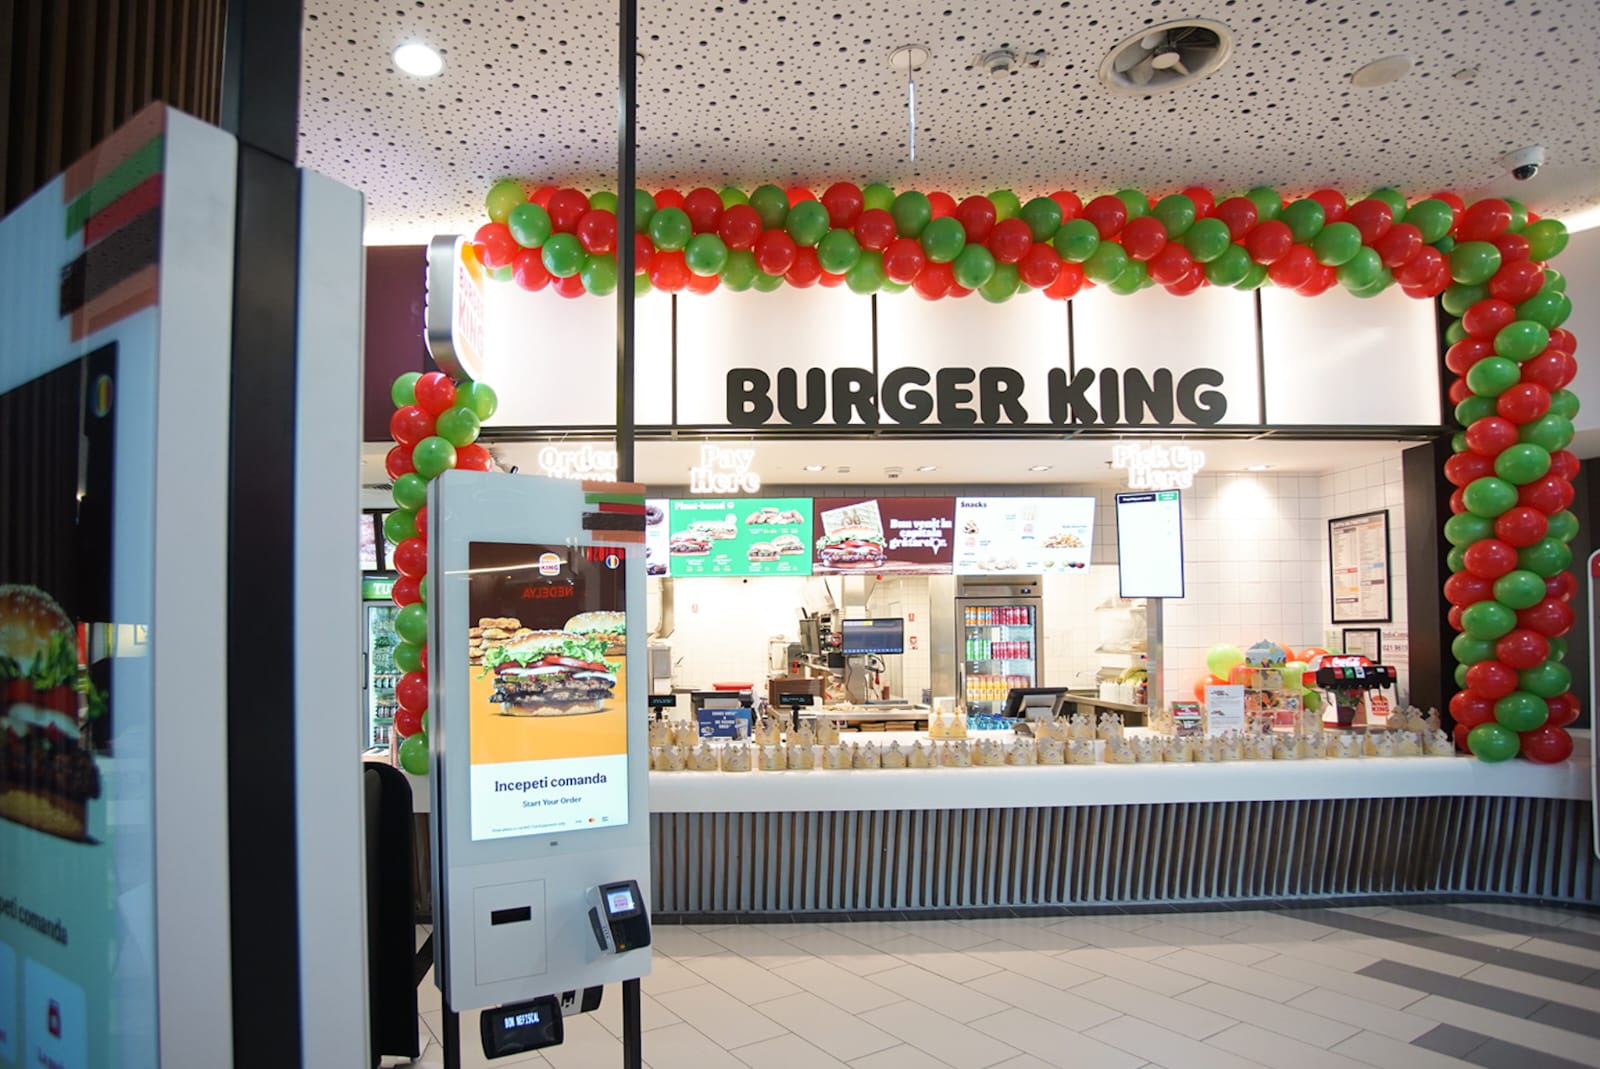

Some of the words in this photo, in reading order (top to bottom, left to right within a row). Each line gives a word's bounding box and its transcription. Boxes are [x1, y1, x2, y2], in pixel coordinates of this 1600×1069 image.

[726, 366, 1028, 425] BURGER
[1048, 366, 1228, 425] KING
[701, 444, 755, 471] Pay
[1112, 444, 1170, 469] Pick
[1170, 446, 1205, 474] Up
[690, 467, 760, 493] Here
[1128, 465, 1192, 491] Here
[494, 776, 548, 792] Incepeti
[550, 772, 607, 787] comanda
[522, 800, 541, 808] Start
[543, 798, 559, 807] Your
[560, 796, 582, 804] Order
[18, 905, 68, 946] comanda
[515, 1011, 540, 1027] NEFISCAL
